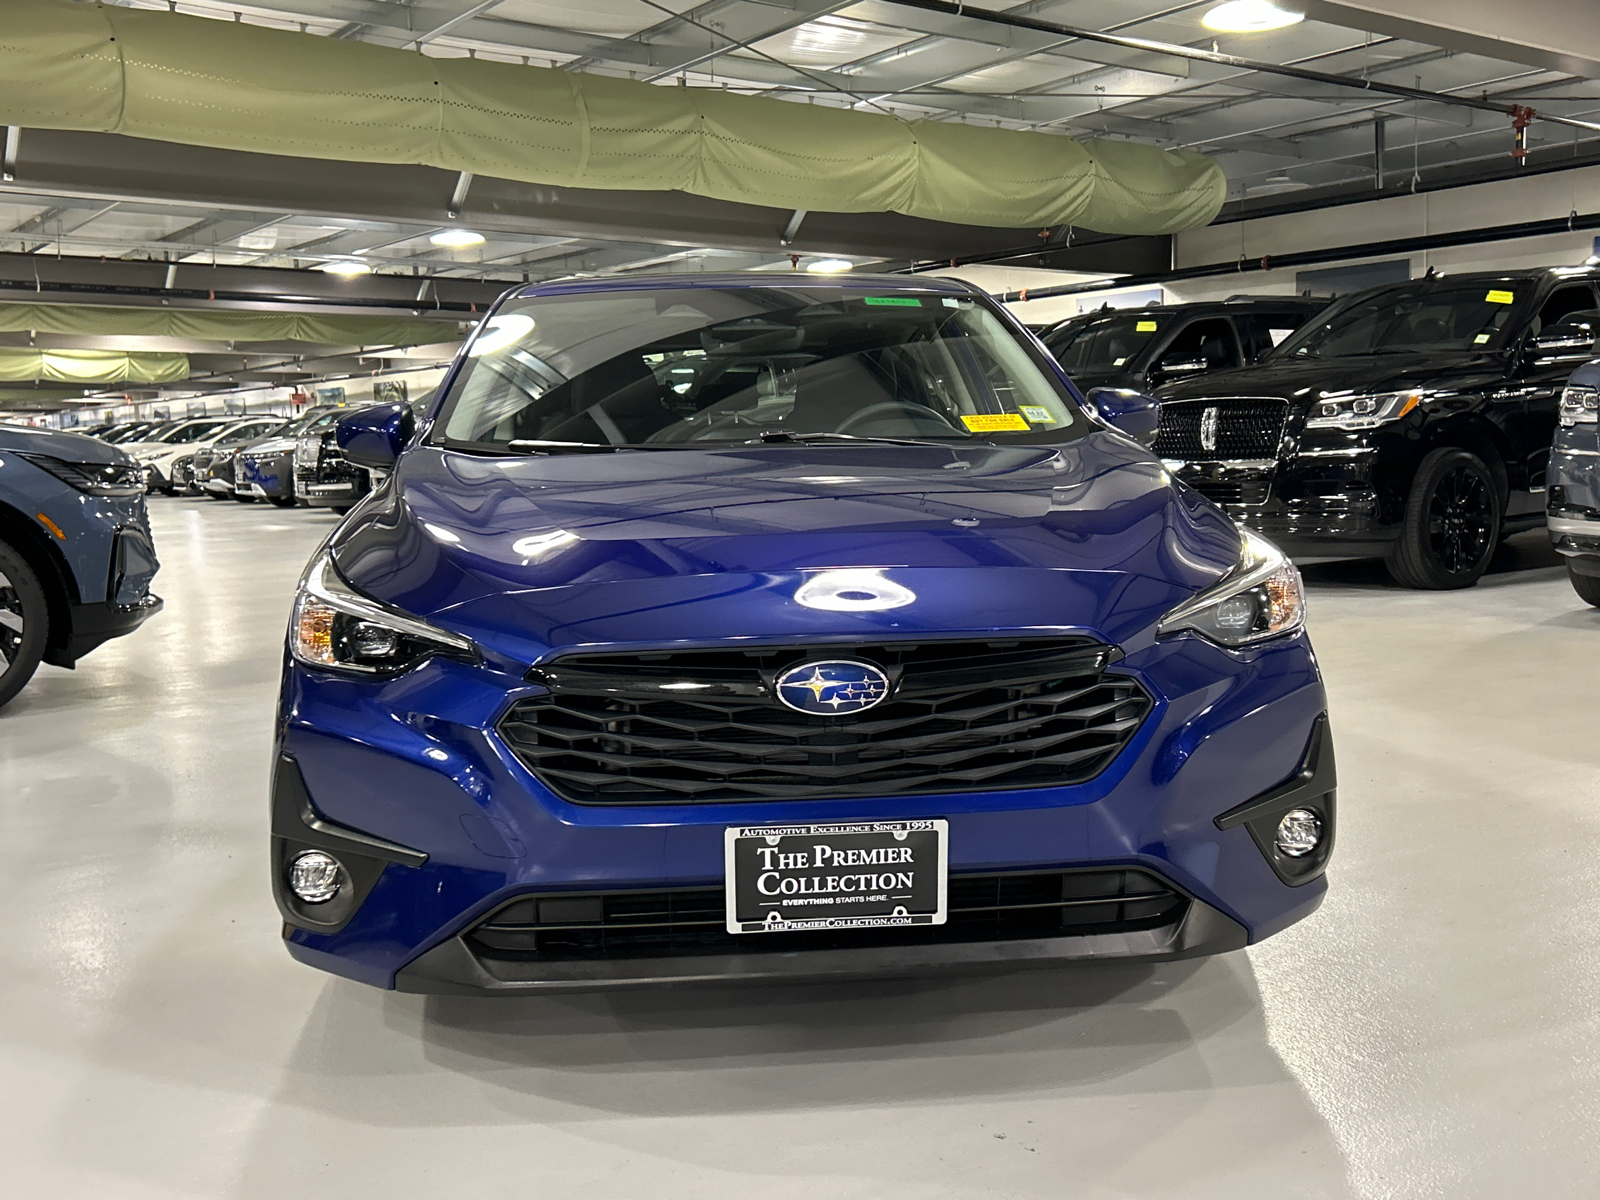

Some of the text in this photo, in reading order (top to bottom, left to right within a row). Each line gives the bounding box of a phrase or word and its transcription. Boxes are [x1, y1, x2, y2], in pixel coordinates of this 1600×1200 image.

[742, 821, 933, 837] AUTOMOTIVE EXCELLENCE SINCE 1995
[757, 845, 914, 870] THE PREMIER
[756, 871, 914, 895] COLLECTION
[782, 897, 834, 906] EVERYTHING
[835, 895, 865, 903] STARTS
[762, 917, 912, 931] THEPREMIERCOLLECTION.COM
